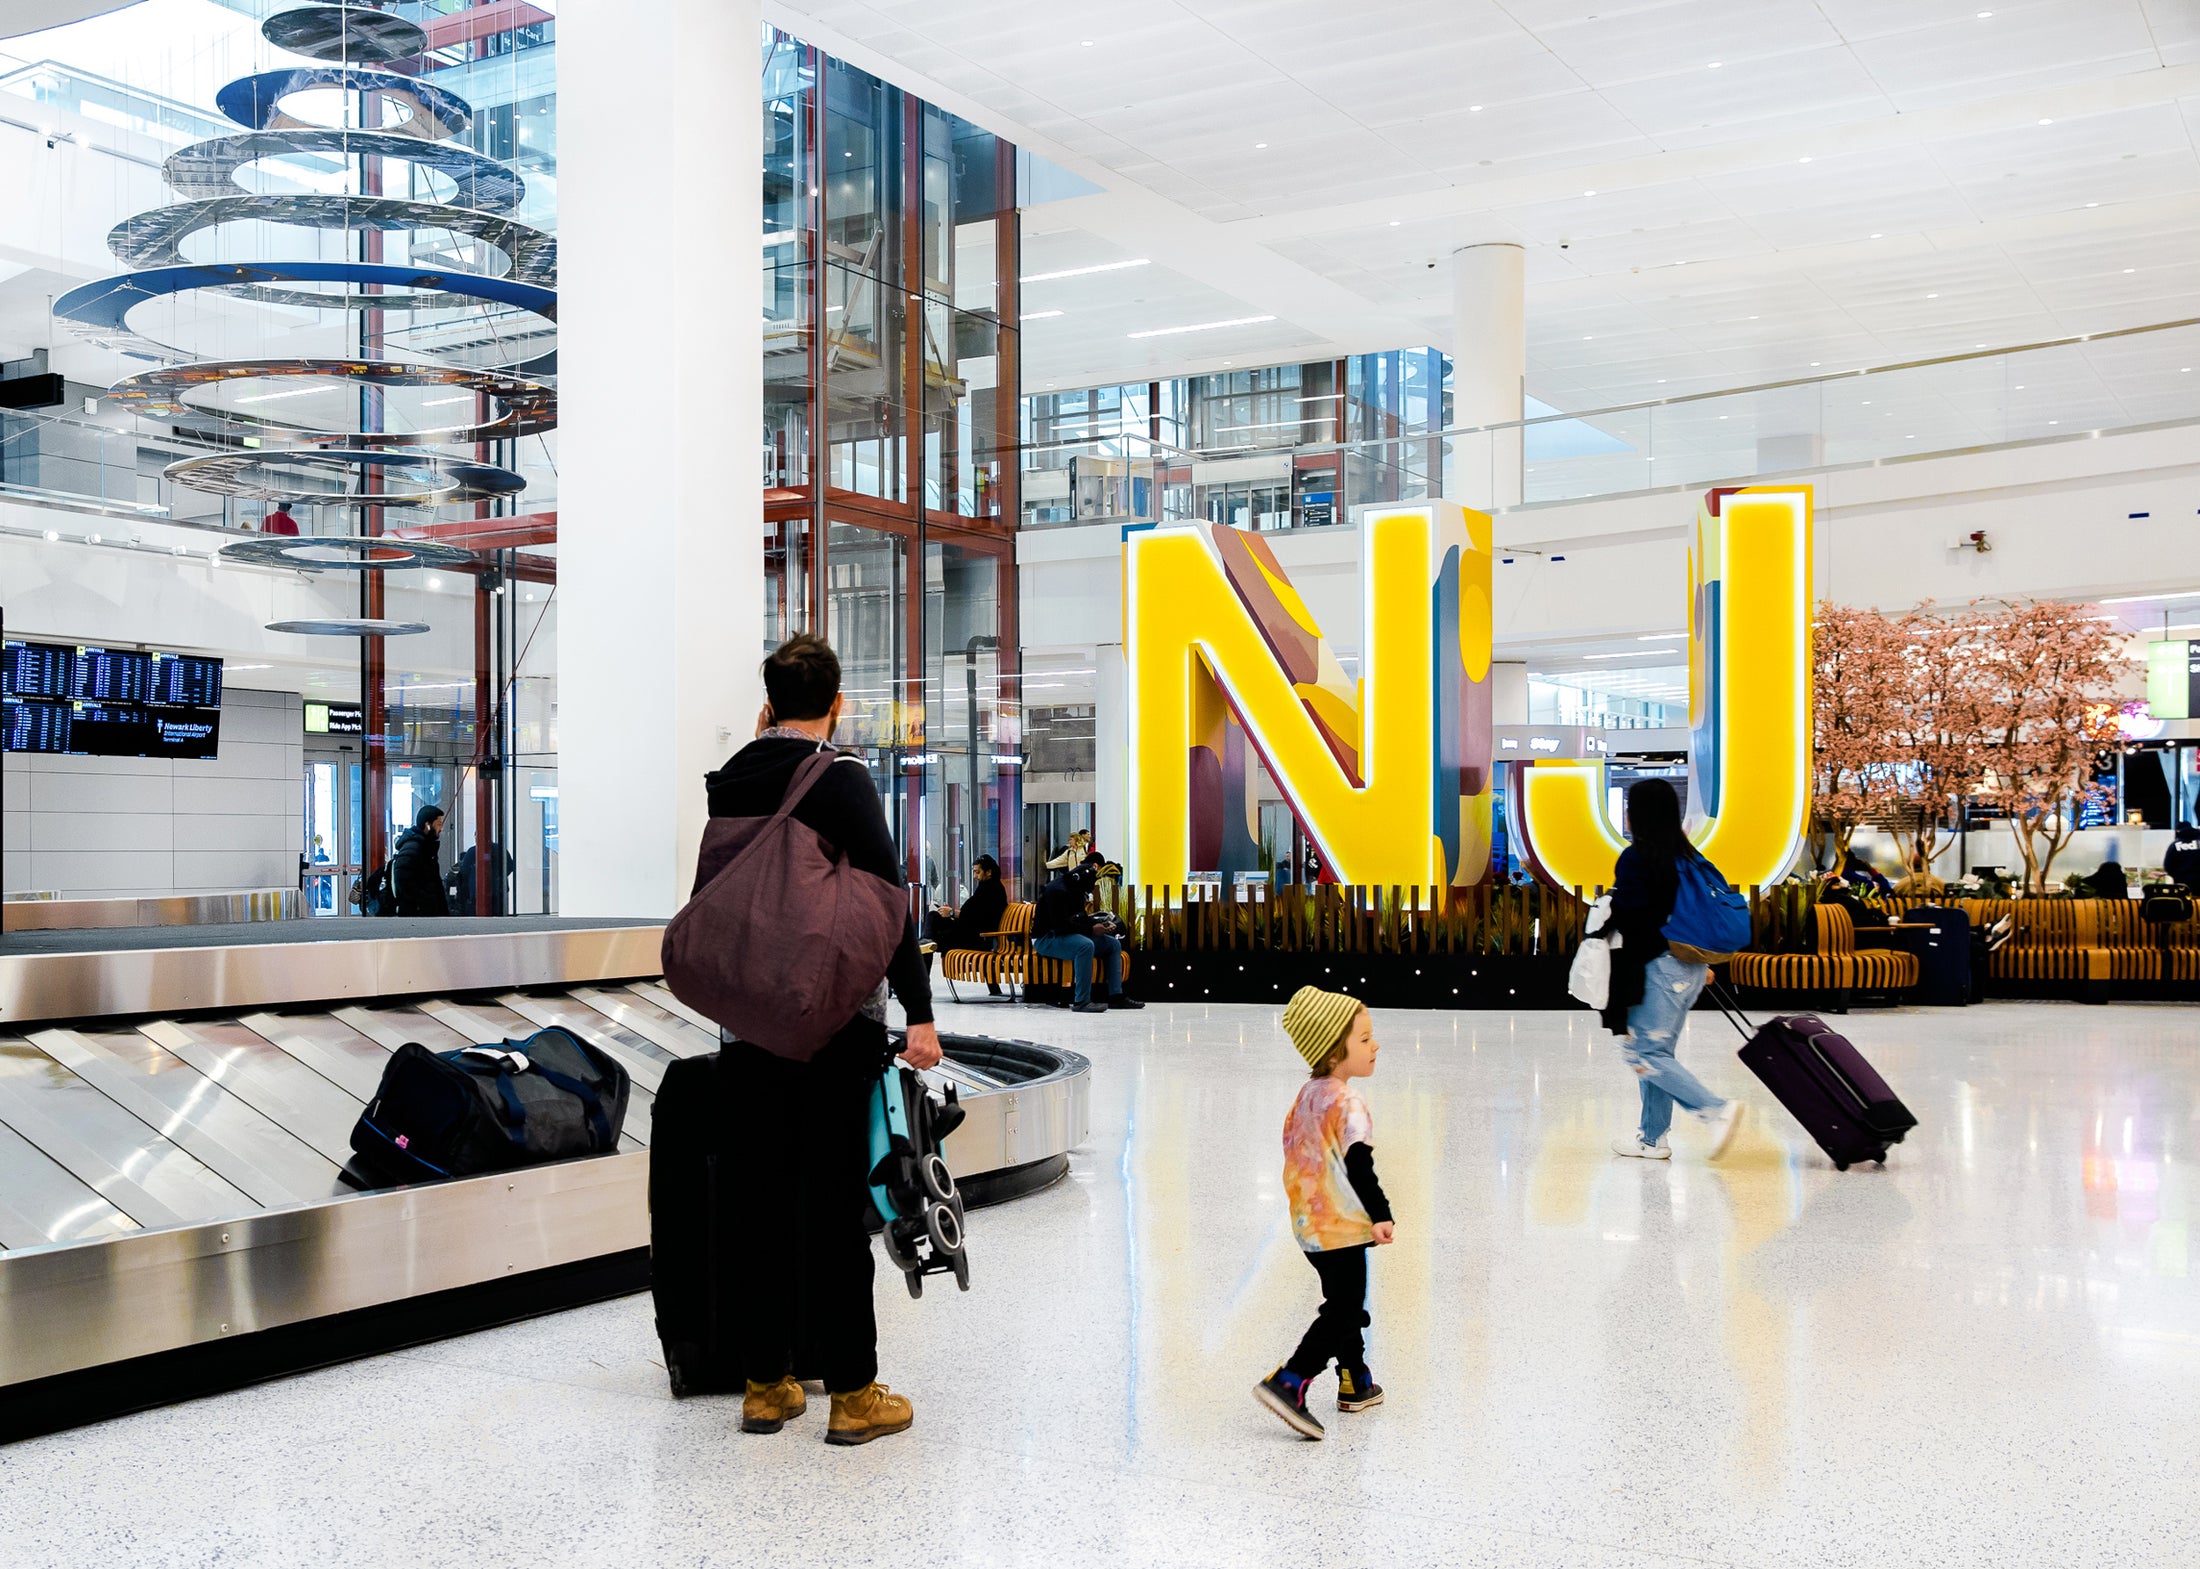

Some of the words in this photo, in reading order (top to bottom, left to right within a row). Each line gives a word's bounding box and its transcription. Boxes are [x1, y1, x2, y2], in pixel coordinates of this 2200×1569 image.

[1126, 503, 1434, 909] N
[1519, 489, 1810, 900] J
[329, 709, 354, 718] Passenger
[164, 723, 189, 731] Newark
[189, 724, 212, 733] Liberty
